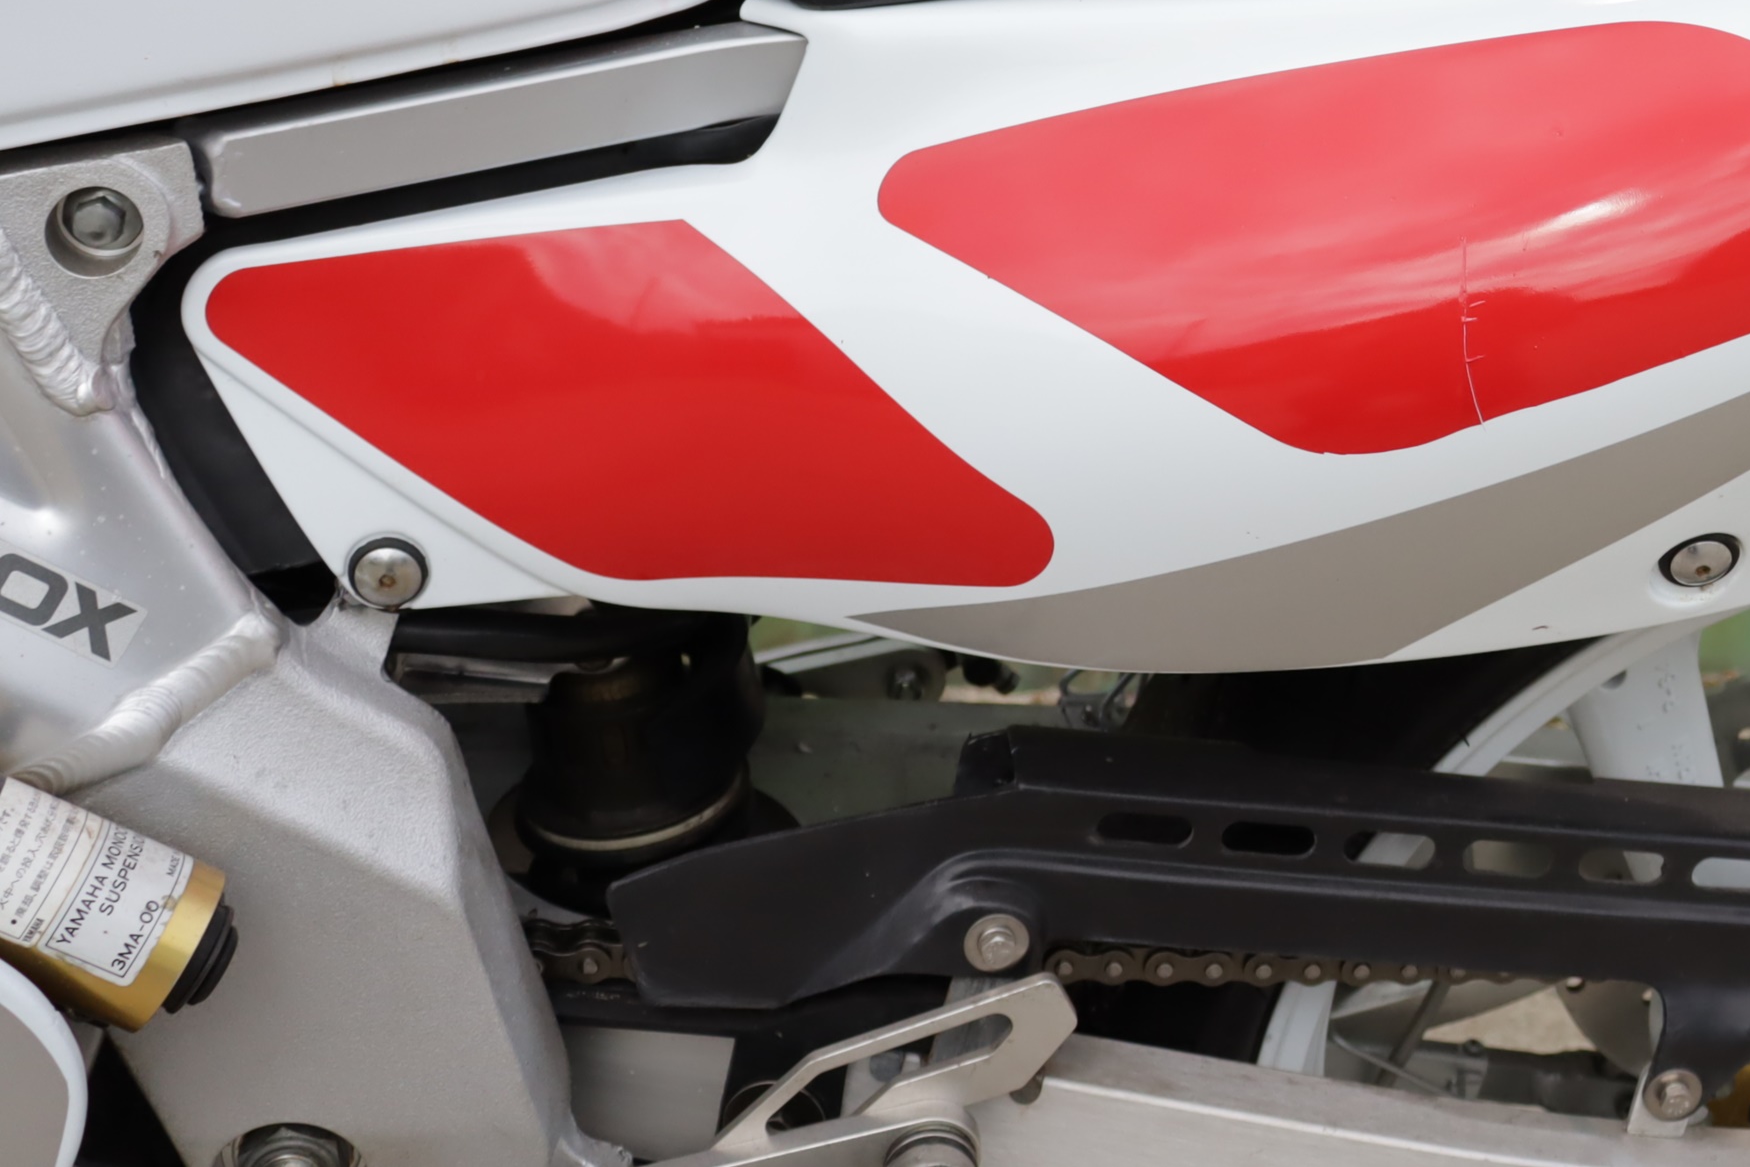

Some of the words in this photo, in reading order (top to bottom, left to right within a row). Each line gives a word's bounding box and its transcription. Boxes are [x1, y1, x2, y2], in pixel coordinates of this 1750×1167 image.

[0, 553, 138, 661] OX
[23, 917, 44, 942] YAMAHA
[56, 875, 109, 945] YAMAHA
[111, 900, 159, 971] 3MA-00
